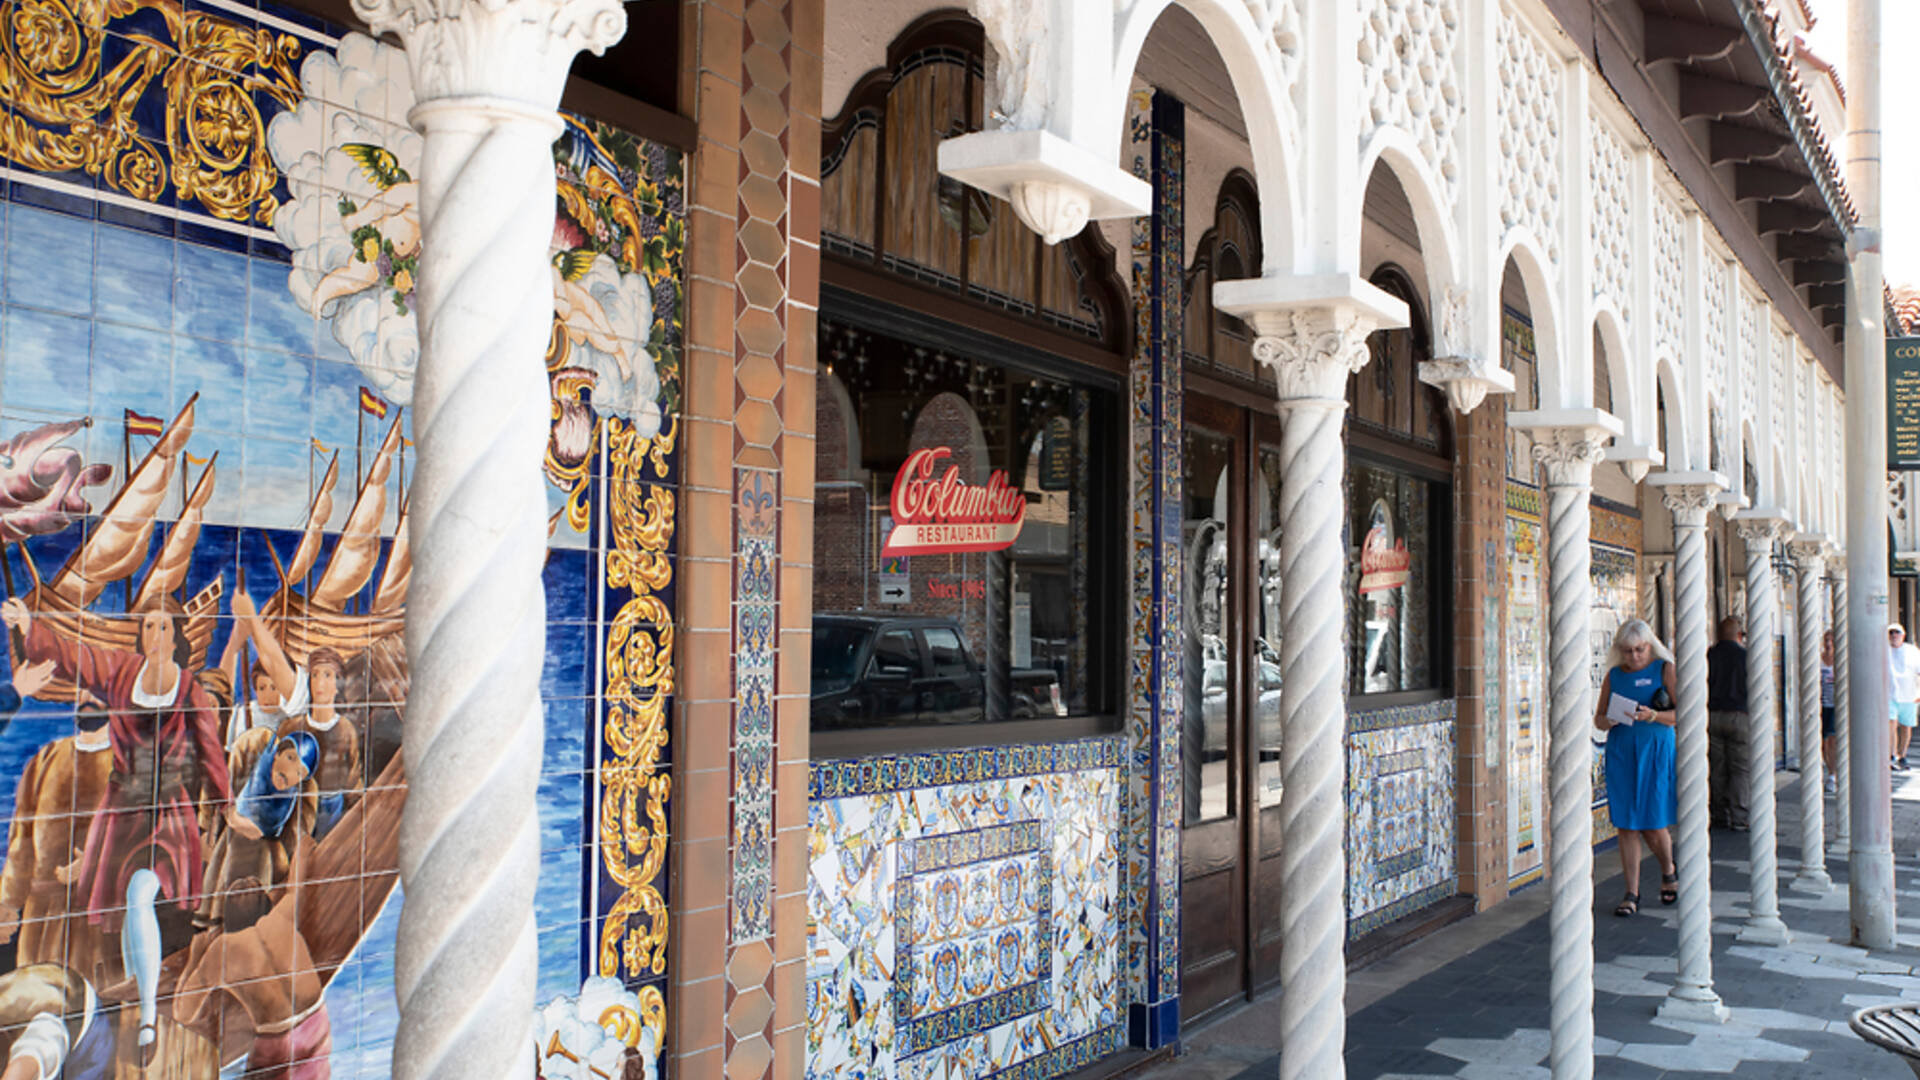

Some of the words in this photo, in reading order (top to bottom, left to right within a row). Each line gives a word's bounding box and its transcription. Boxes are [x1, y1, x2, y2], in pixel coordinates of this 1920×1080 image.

[1895, 346, 1920, 358] CO
[895, 446, 1022, 520] Columbia
[916, 526, 998, 543] RESTAURANT
[927, 577, 958, 598] Since
